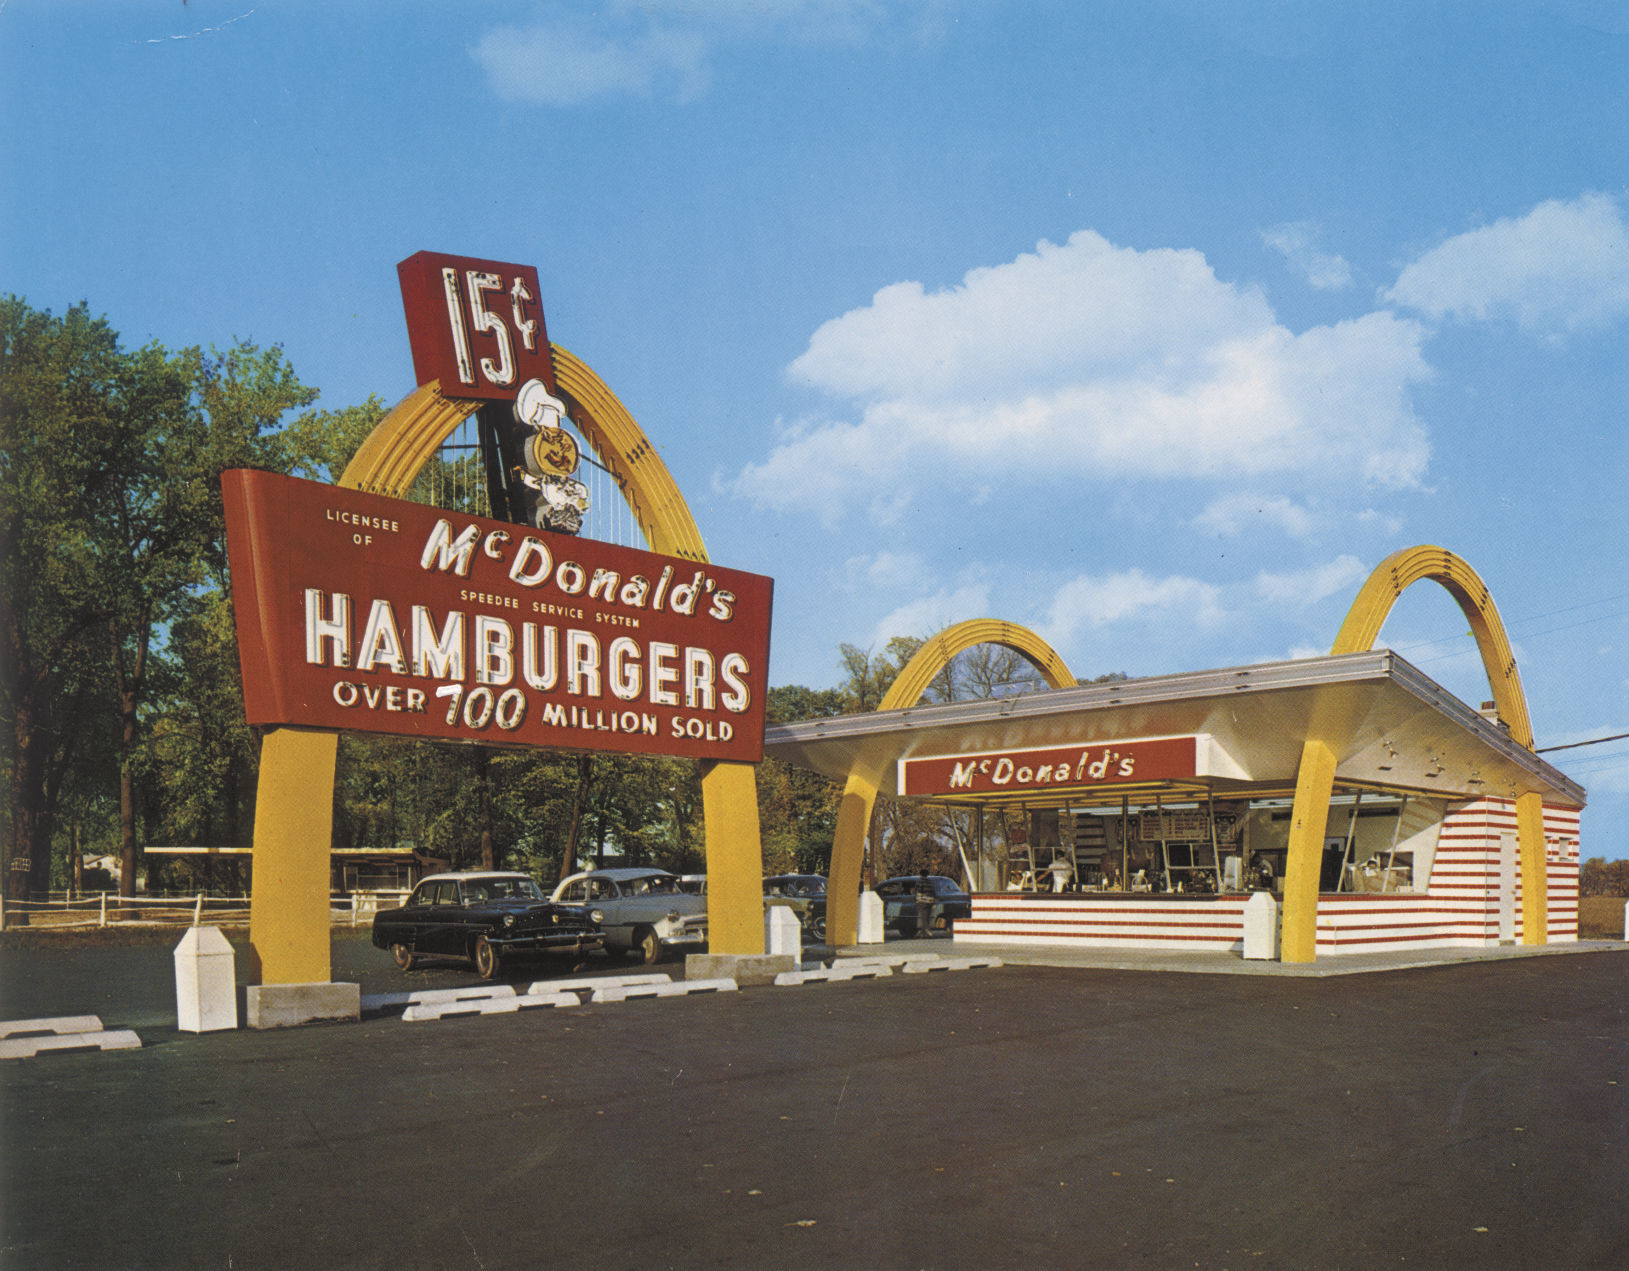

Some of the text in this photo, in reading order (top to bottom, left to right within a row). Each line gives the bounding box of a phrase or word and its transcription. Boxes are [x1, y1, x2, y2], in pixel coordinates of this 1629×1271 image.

[442, 267, 538, 385] 15¢
[326, 509, 400, 532] LICENSEE
[352, 533, 373, 546] OF
[420, 518, 737, 621] McDonald's
[460, 590, 640, 629] SPEEDEE SERVICE SYSTEM
[305, 588, 751, 712] HAMBURGERS
[333, 680, 735, 742] OVER 700 MILLION SOLD
[949, 749, 1134, 788] McDonald's
